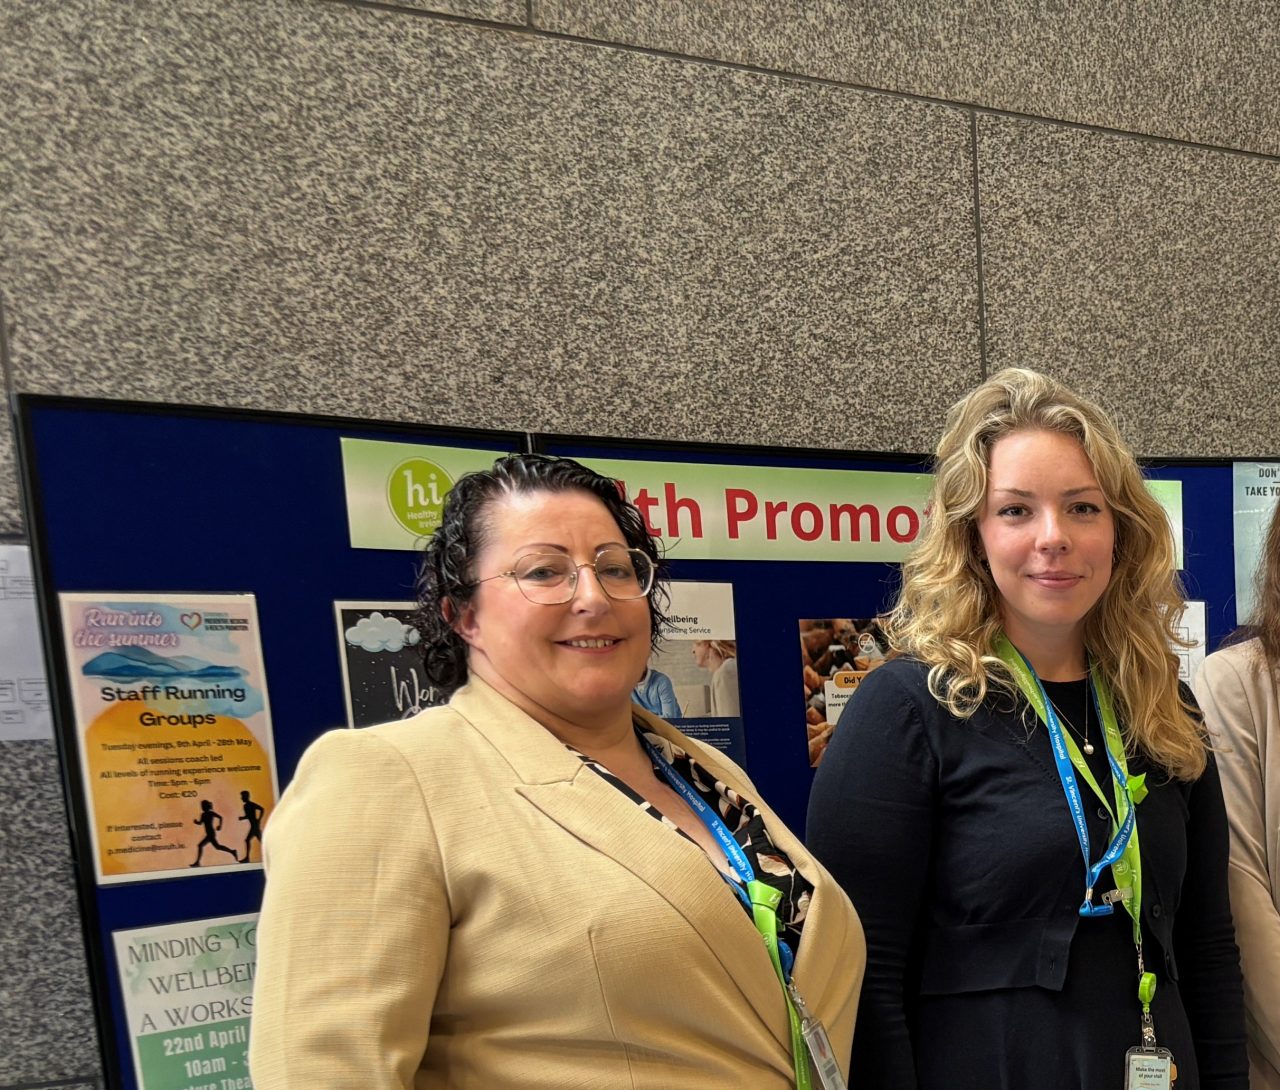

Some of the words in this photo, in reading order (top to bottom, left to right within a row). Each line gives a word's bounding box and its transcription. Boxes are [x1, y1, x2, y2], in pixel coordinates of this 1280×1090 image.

[404, 469, 443, 508] hi
[1245, 486, 1268, 496] TAKE
[1270, 487, 1280, 496] YO
[408, 510, 437, 520] Healthy
[725, 488, 920, 542] Promo
[86, 607, 125, 627] Run
[128, 609, 162, 627] into
[74, 629, 104, 647] the
[109, 633, 178, 648] summer
[101, 685, 160, 702] Staff
[166, 684, 246, 702] Running
[139, 712, 216, 728] Groups
[192, 740, 210, 748] April
[236, 738, 252, 747] May
[1052, 734, 1065, 760] Hospital
[185, 755, 209, 763] coach
[211, 754, 223, 762] led
[140, 768, 149, 776] of
[150, 768, 181, 777] running
[182, 766, 226, 776] experience
[227, 764, 261, 773] welcome
[684, 790, 706, 812] Hospital
[1067, 785, 1082, 814] Vincent's
[128, 934, 222, 964] MINDING
[229, 928, 256, 949] YO
[148, 962, 256, 995] WELLBEI
[140, 1014, 157, 1032] A
[164, 996, 253, 1026] WORKS
[163, 1034, 204, 1056] 22nd
[210, 1026, 246, 1048] April
[184, 1057, 226, 1078] 10am
